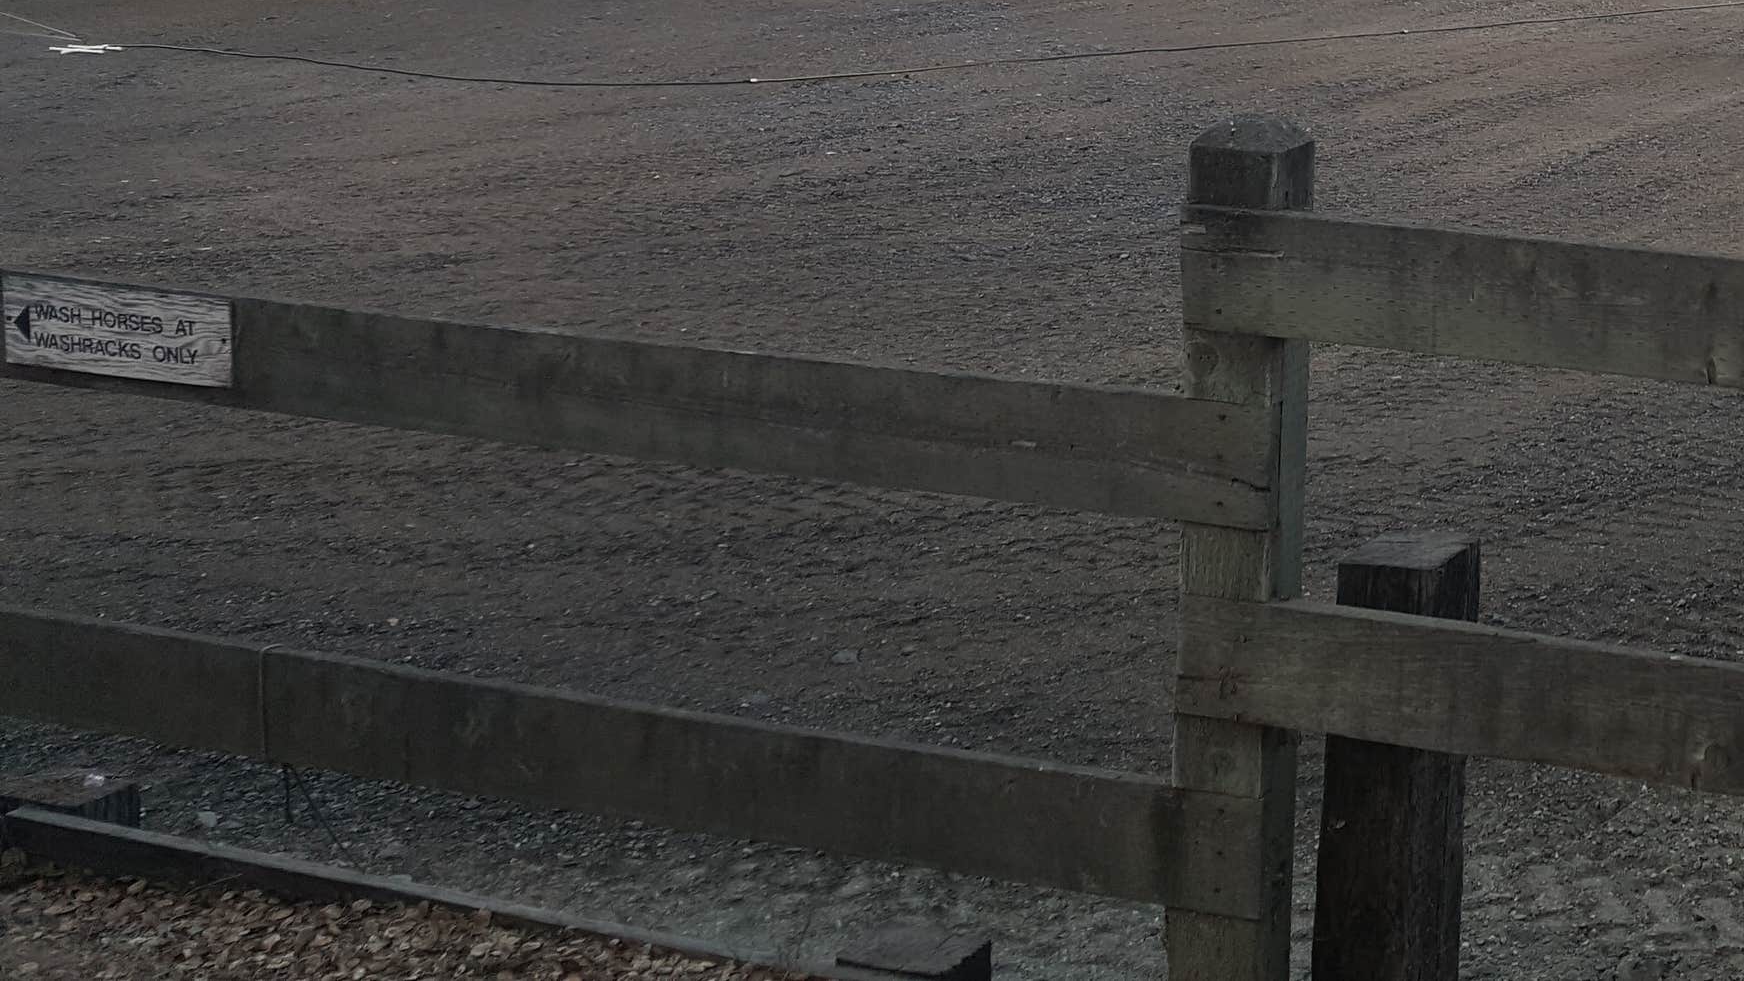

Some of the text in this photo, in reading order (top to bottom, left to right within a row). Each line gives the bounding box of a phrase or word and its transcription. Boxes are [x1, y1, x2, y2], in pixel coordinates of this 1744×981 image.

[35, 304, 197, 336] WASH HORSES AT
[34, 332, 198, 364] WASHRACKS ONLY
